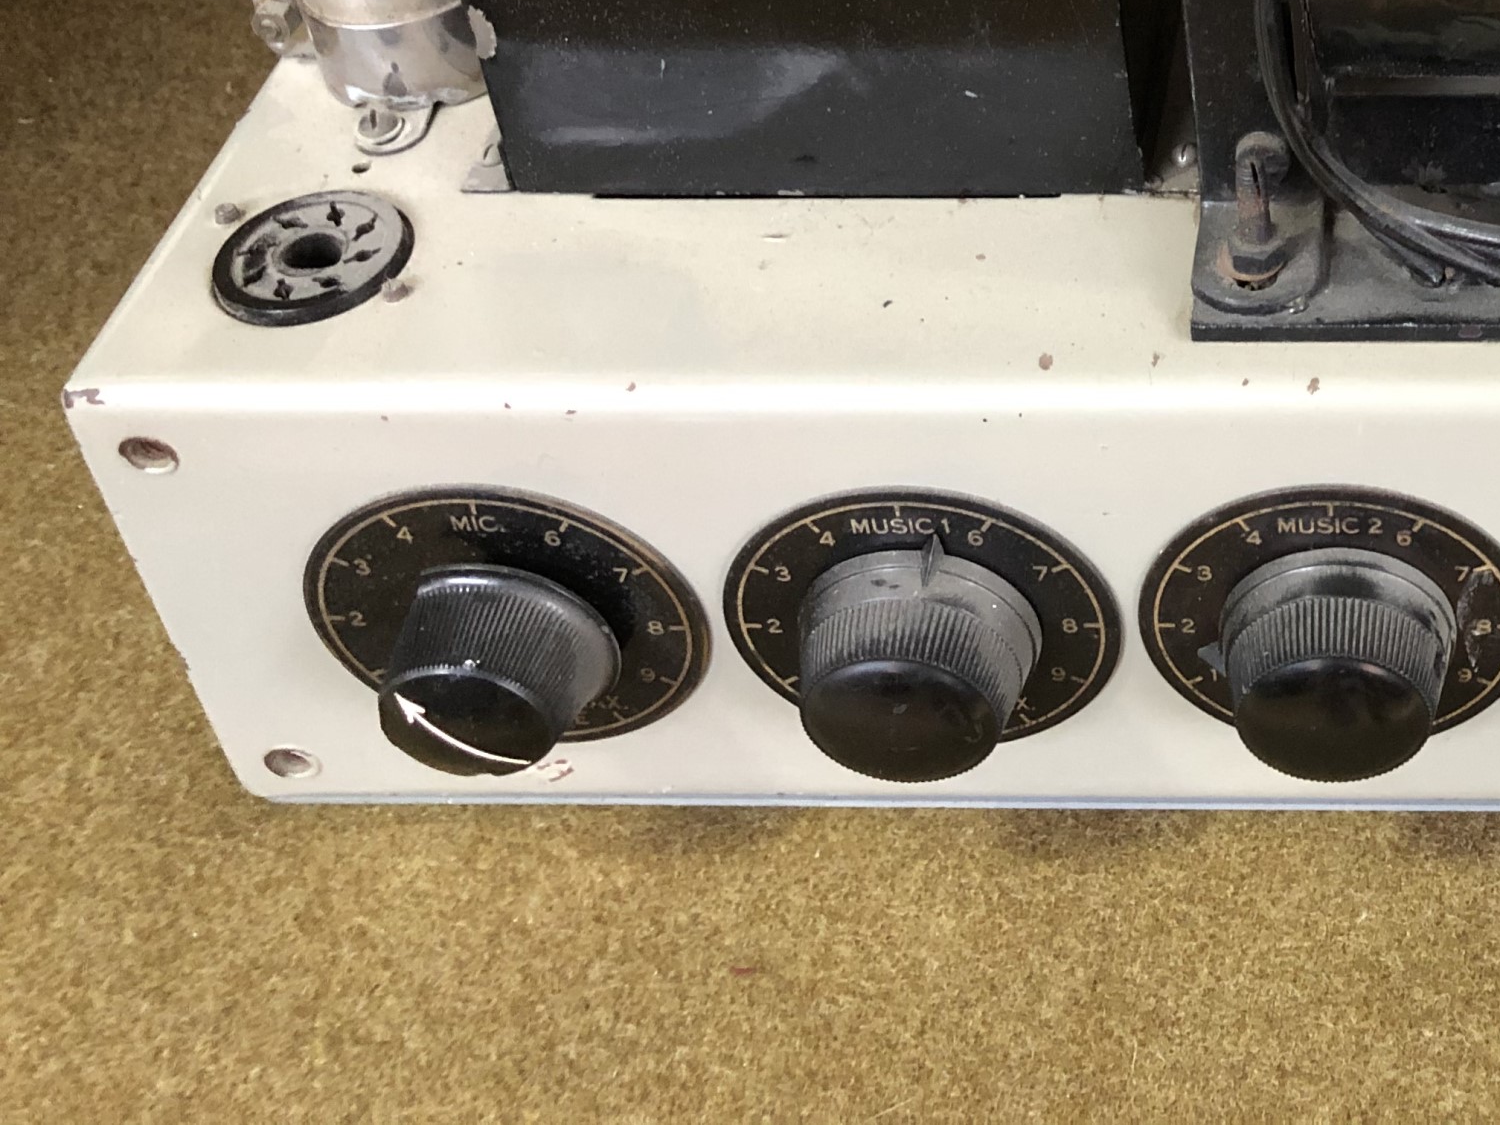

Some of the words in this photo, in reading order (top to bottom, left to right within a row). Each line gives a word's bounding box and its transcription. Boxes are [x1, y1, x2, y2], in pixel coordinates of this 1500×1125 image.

[450, 515, 505, 533] MIC.
[850, 518, 935, 535] MUSIC
[941, 519, 951, 534] 1
[1277, 518, 1359, 535] MUSIC
[1368, 519, 1383, 534] 2
[397, 526, 414, 543] 4
[544, 531, 561, 546] 6
[819, 530, 835, 547] 4
[967, 530, 984, 547] 6
[1247, 530, 1262, 546] 4
[1396, 531, 1411, 546] 6
[354, 559, 370, 576] 3
[775, 566, 791, 581] 3
[1032, 566, 1047, 581] 7
[1196, 566, 1212, 581] 3
[1455, 566, 1469, 581] 7
[614, 568, 629, 583] 7
[351, 611, 366, 626] 2
[1061, 618, 1077, 633] 8
[647, 620, 663, 635] 8
[767, 619, 783, 634] 2
[1182, 620, 1197, 633] 2
[640, 668, 655, 683] 9
[1051, 667, 1066, 681] 9
[1458, 669, 1473, 682] 9
